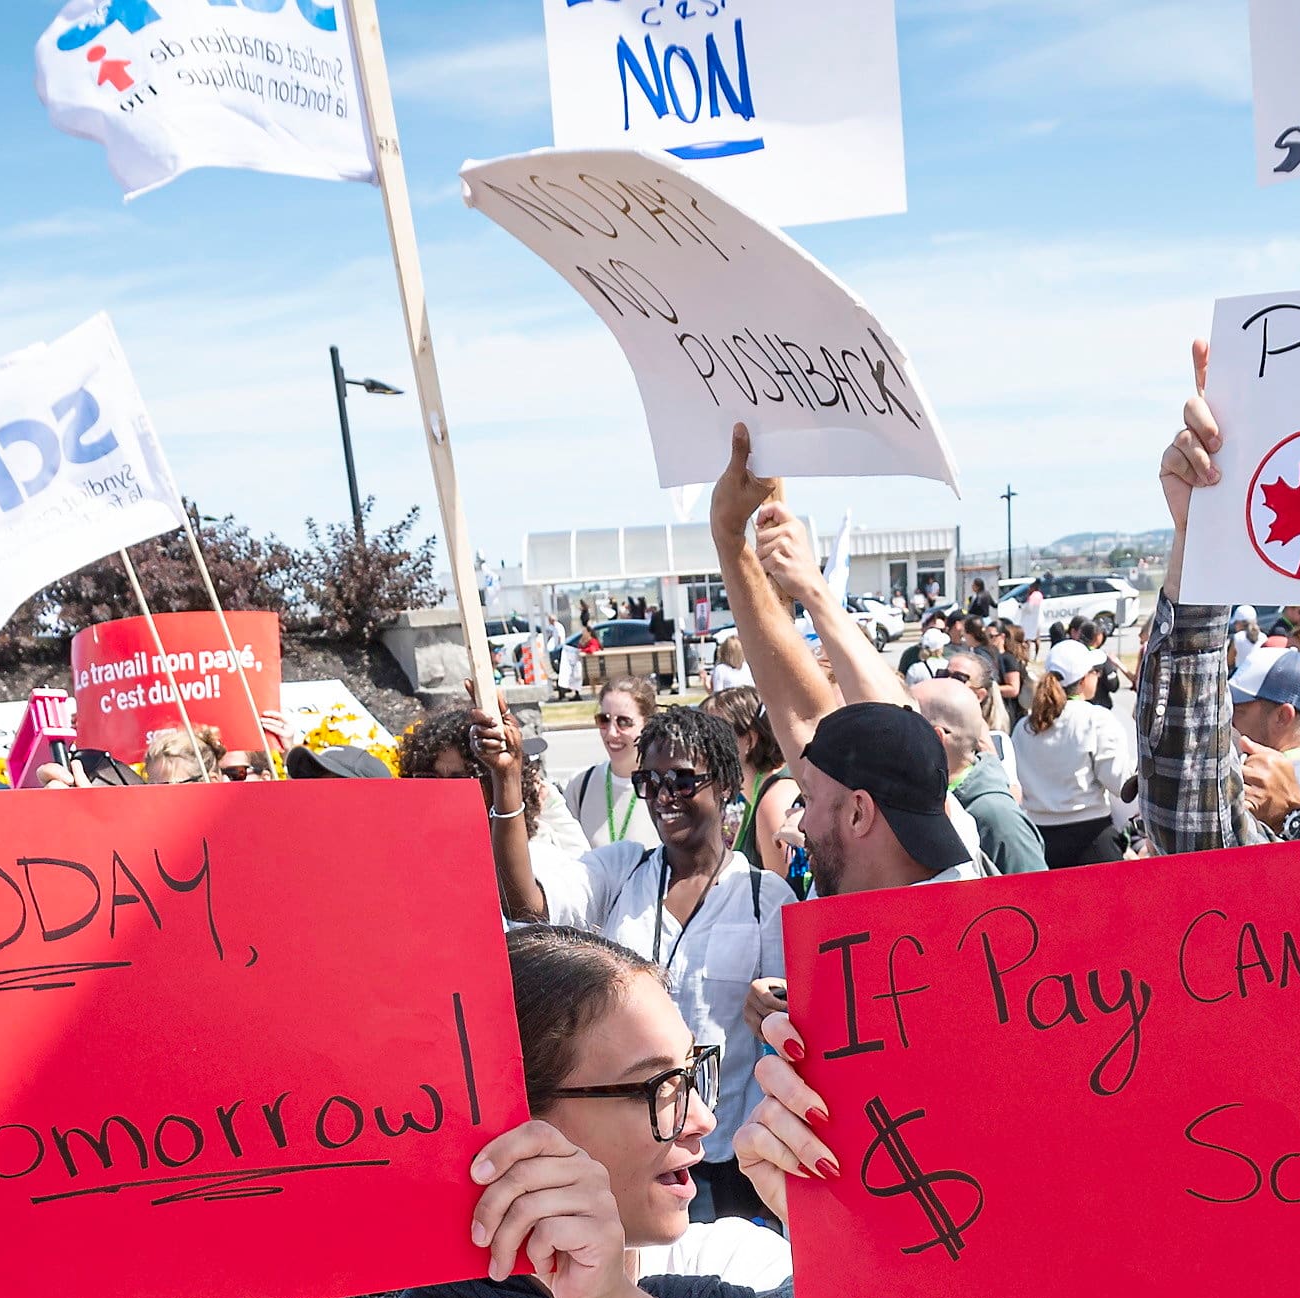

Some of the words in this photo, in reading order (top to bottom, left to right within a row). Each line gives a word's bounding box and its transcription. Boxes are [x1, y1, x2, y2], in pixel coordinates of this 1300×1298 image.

[617, 18, 755, 130] NON
[481, 175, 618, 238] NO
[576, 258, 678, 324] NO
[675, 328, 921, 430] PUSHBACK!
[91, 651, 148, 685] travail
[152, 653, 195, 675] non
[100, 690, 146, 713] c'est
[149, 681, 176, 705] du
[180, 675, 220, 702] vol!
[819, 932, 929, 1060] If
[958, 906, 1151, 1095] Pay
[861, 1096, 984, 1262] $
